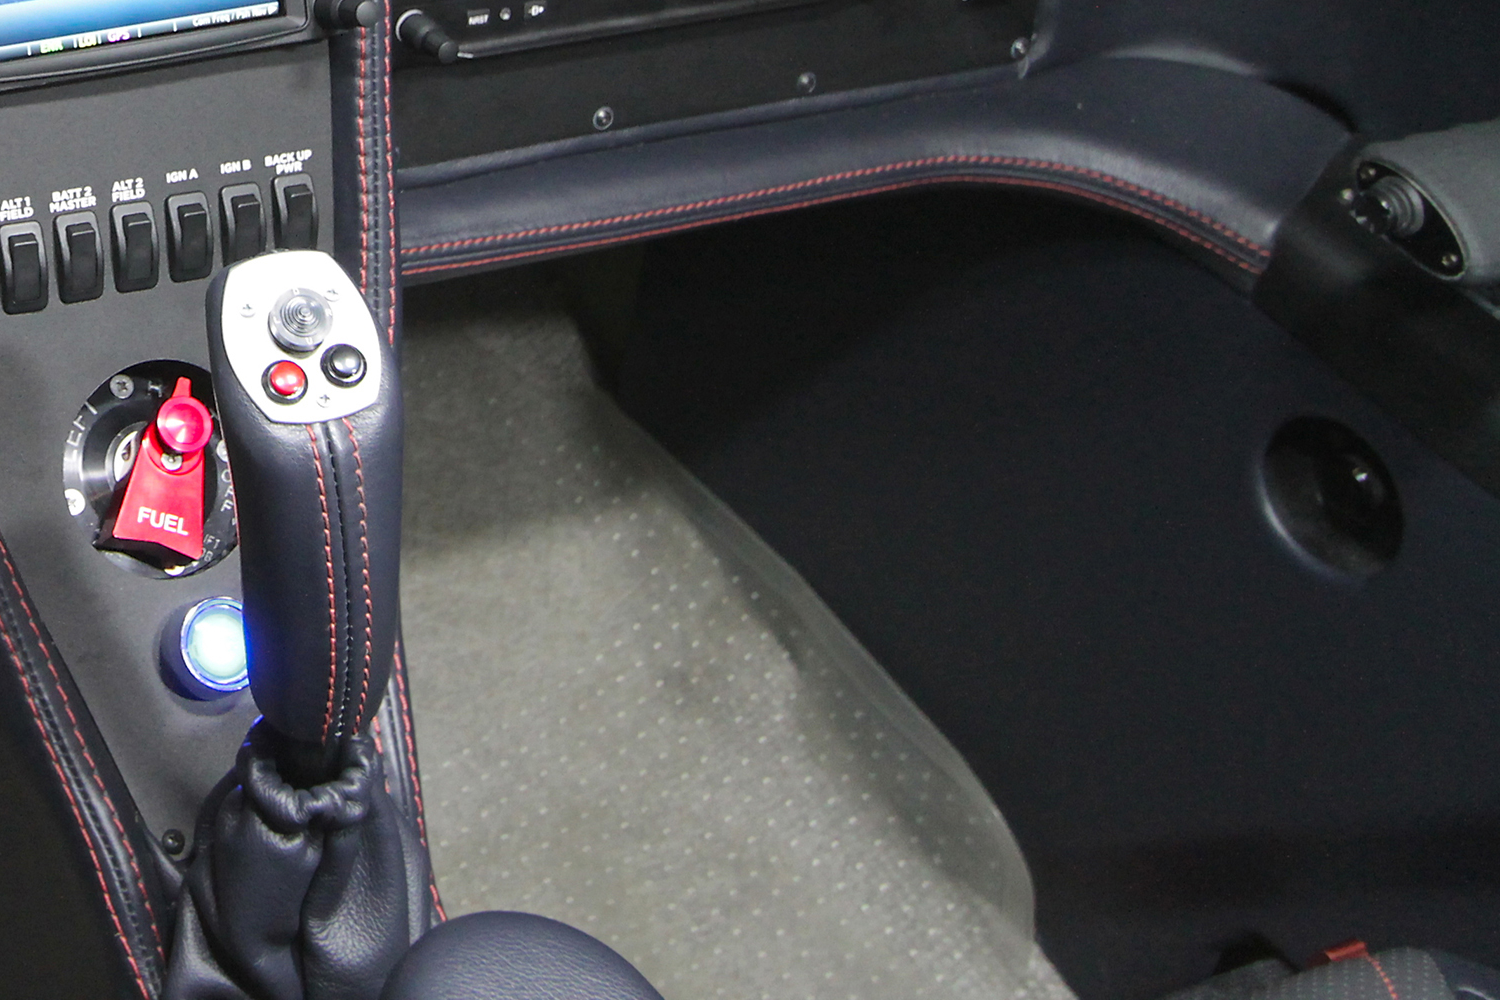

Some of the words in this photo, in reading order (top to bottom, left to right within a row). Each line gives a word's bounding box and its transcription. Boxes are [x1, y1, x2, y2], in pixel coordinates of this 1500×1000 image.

[108, 28, 130, 43] GPS
[220, 160, 240, 174] IGN
[242, 160, 251, 172] B
[264, 154, 294, 168] BACK
[296, 150, 312, 164] UP
[166, 169, 185, 184] IGN
[187, 168, 199, 181] A
[276, 162, 303, 176] PWR
[112, 181, 133, 195] ALT
[135, 178, 144, 190] 2
[52, 189, 83, 204] BATT
[84, 186, 93, 198] 2
[112, 188, 146, 203] FIELD
[0, 197, 21, 212] ALT
[49, 197, 96, 214] MASTER
[0, 206, 34, 222] FIELD
[137, 507, 188, 536] FUEL
